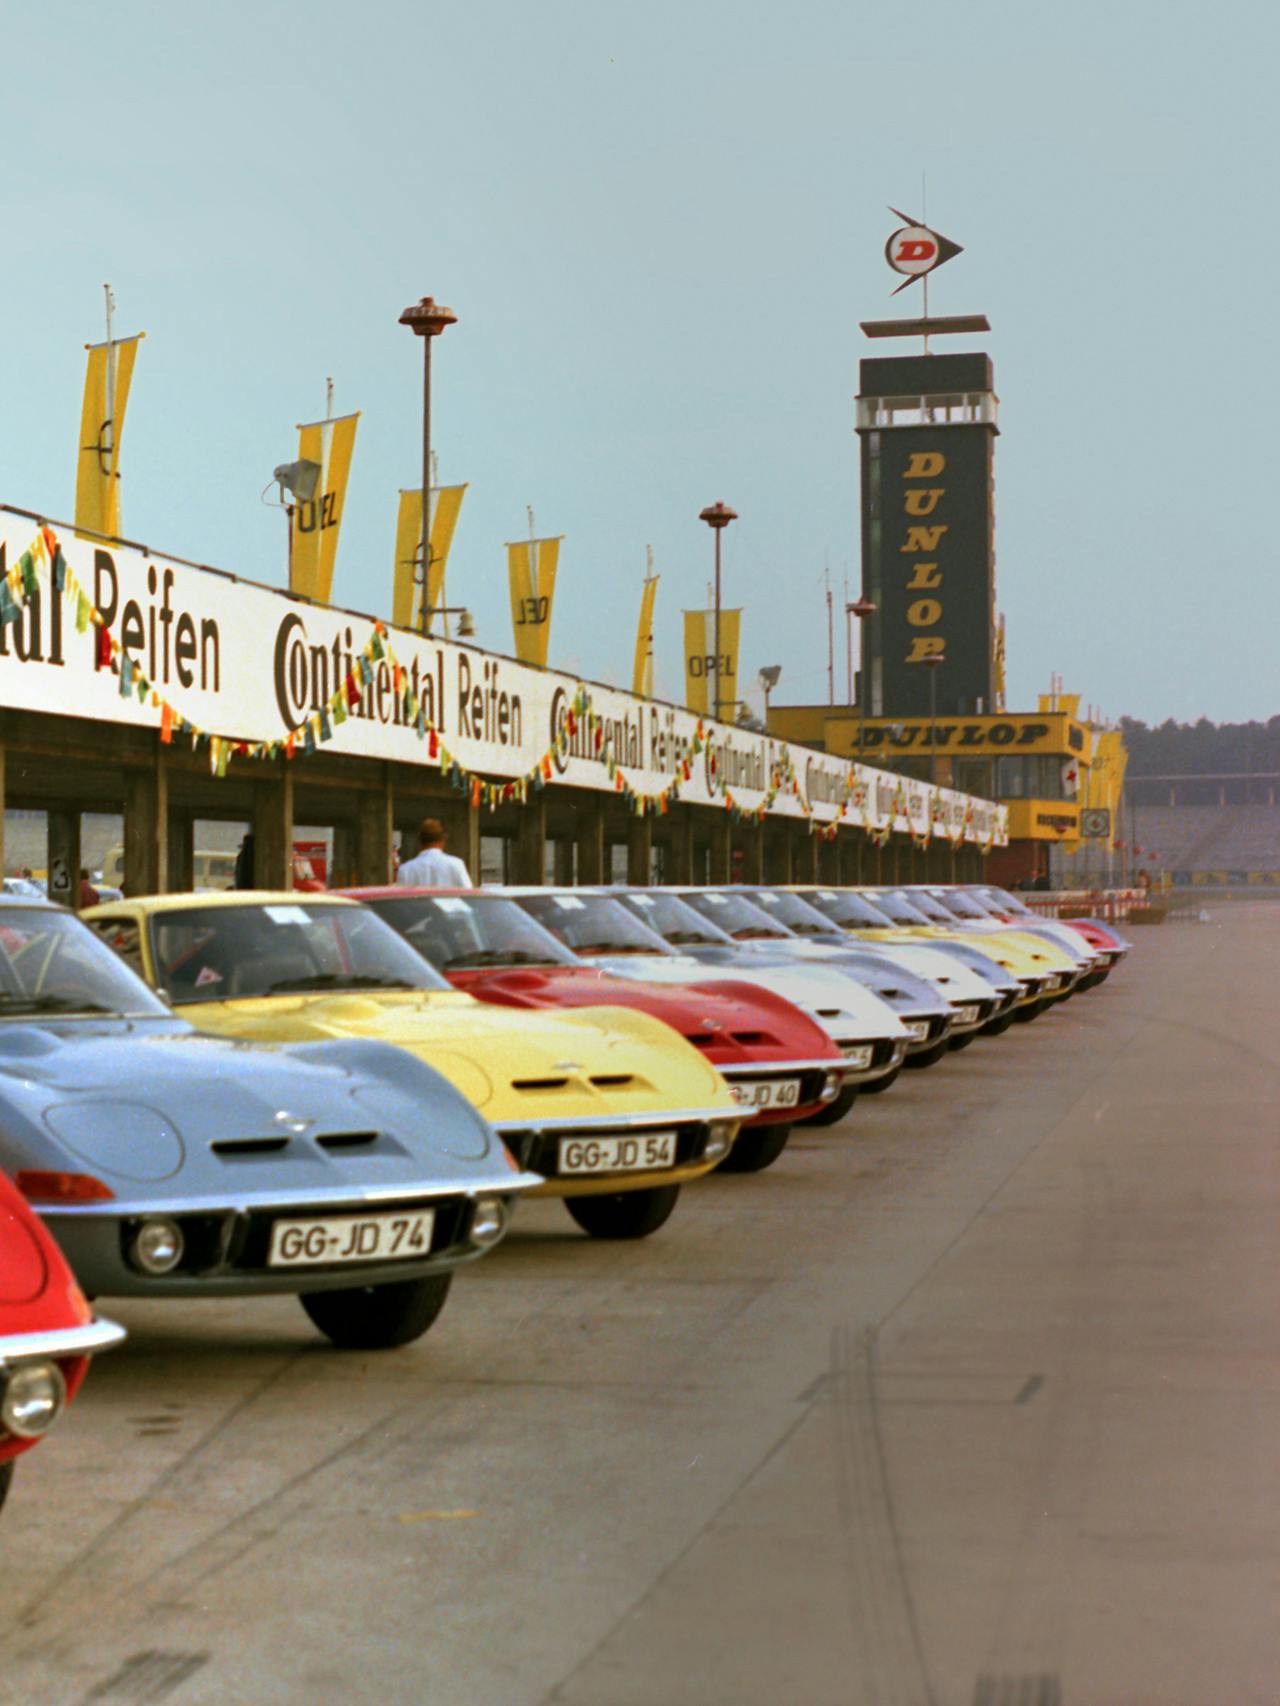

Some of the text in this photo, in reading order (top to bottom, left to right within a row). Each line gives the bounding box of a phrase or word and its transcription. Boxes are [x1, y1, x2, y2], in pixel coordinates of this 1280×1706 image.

[895, 239, 936, 262] D
[900, 452, 948, 664] DUNLOP
[94, 548, 220, 693] Reifen
[273, 612, 522, 748] Continental Reifen
[851, 723, 1049, 748] DUNLOP
[565, 1134, 671, 1171] GG-JD 54
[279, 1213, 426, 1260] GG-JD 74
